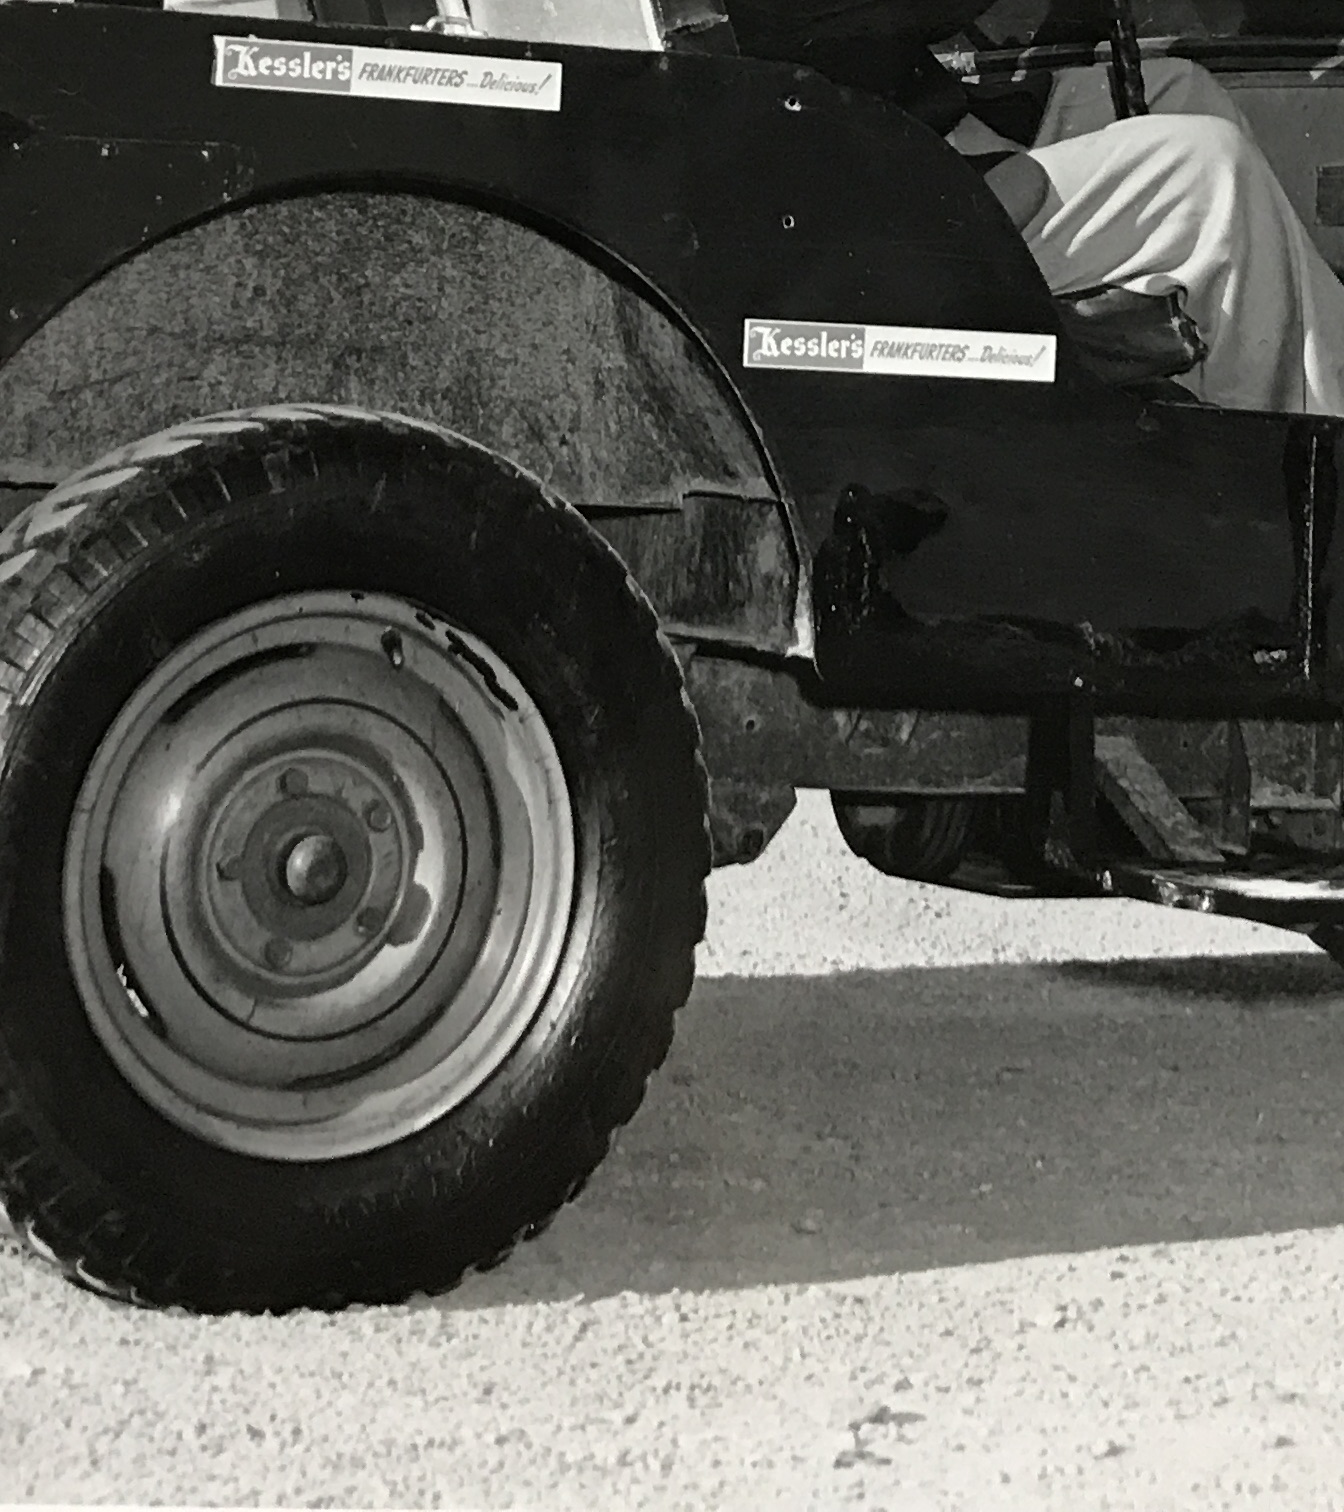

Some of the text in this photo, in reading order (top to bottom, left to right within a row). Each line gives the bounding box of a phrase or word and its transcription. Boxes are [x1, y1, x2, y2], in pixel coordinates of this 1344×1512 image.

[225, 43, 350, 81] Kessler's
[358, 62, 468, 88] FRANKFURTERS
[480, 71, 552, 96] Delicious!
[750, 326, 864, 362] Kessler's
[870, 340, 971, 363] FRANKFURTERS
